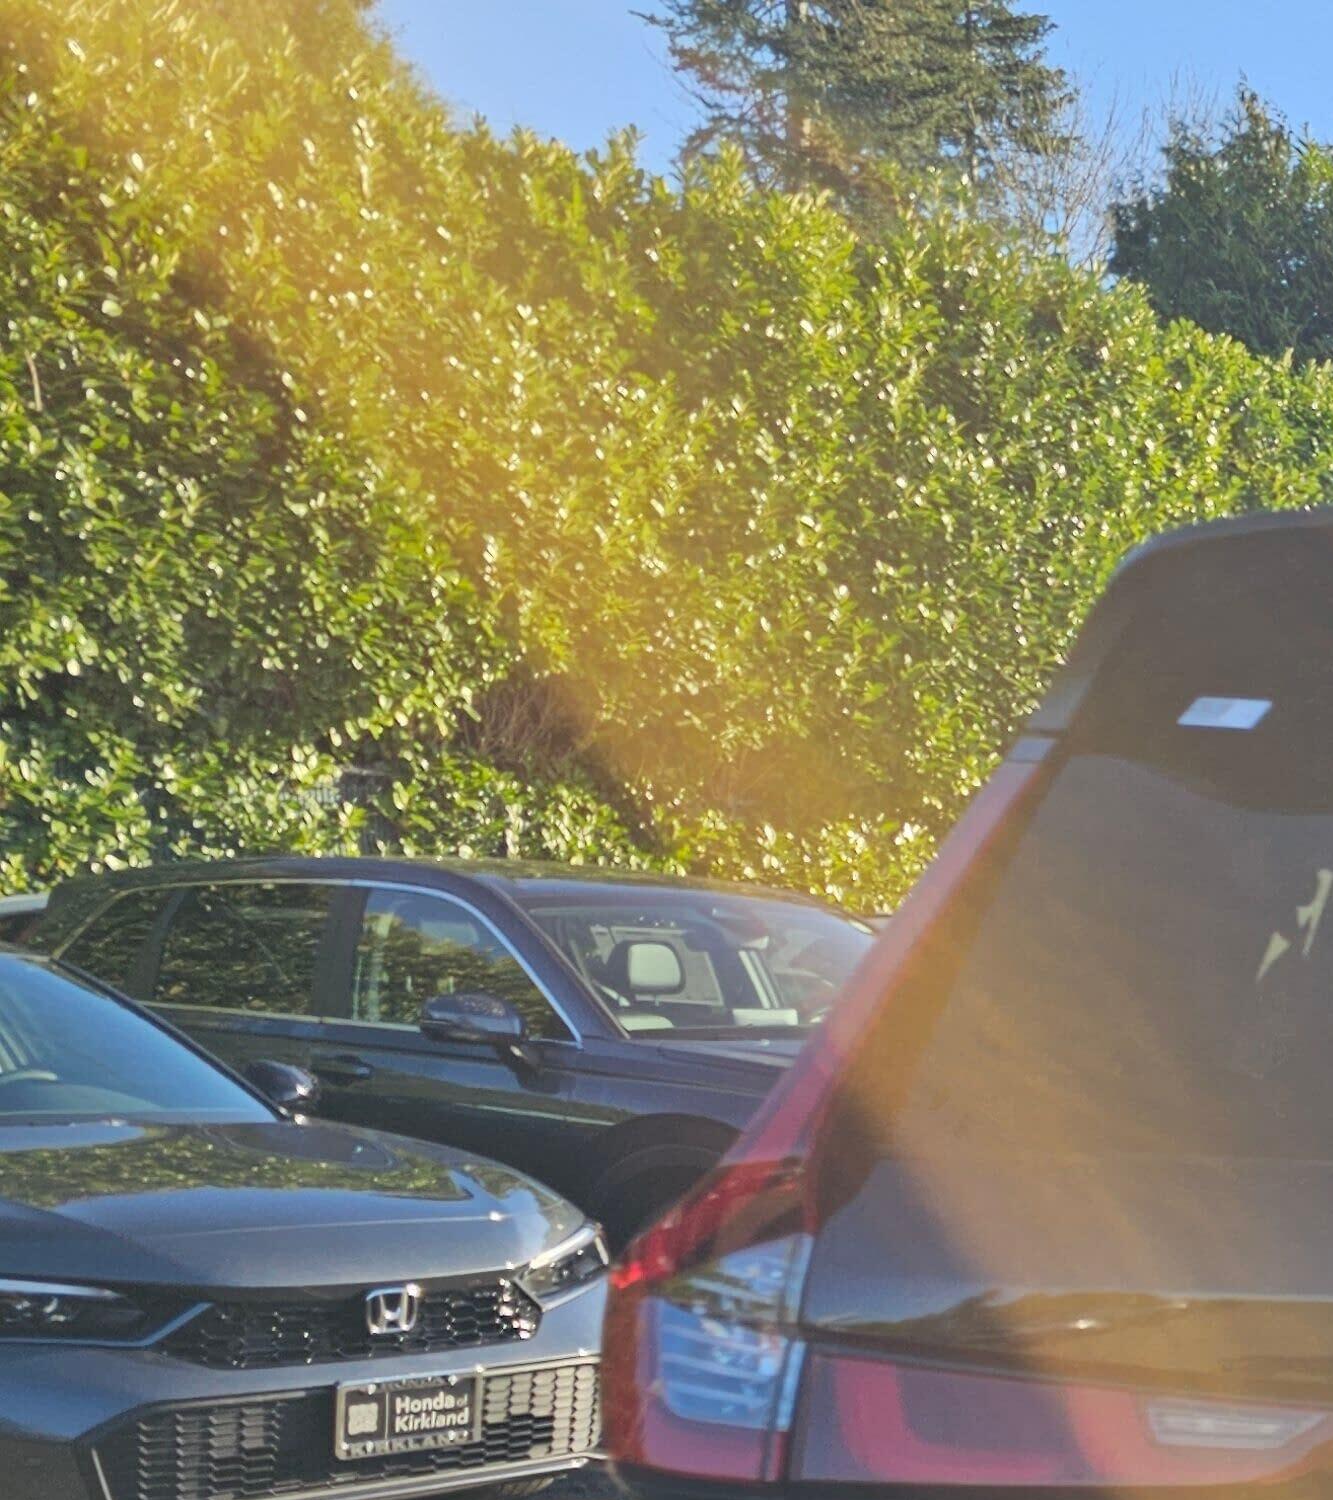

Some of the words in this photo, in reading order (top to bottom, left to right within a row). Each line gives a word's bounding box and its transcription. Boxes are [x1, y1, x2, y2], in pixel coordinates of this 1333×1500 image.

[395, 1391, 456, 1415] Honda
[456, 1393, 468, 1406] of
[394, 1407, 470, 1433] Kirkland
